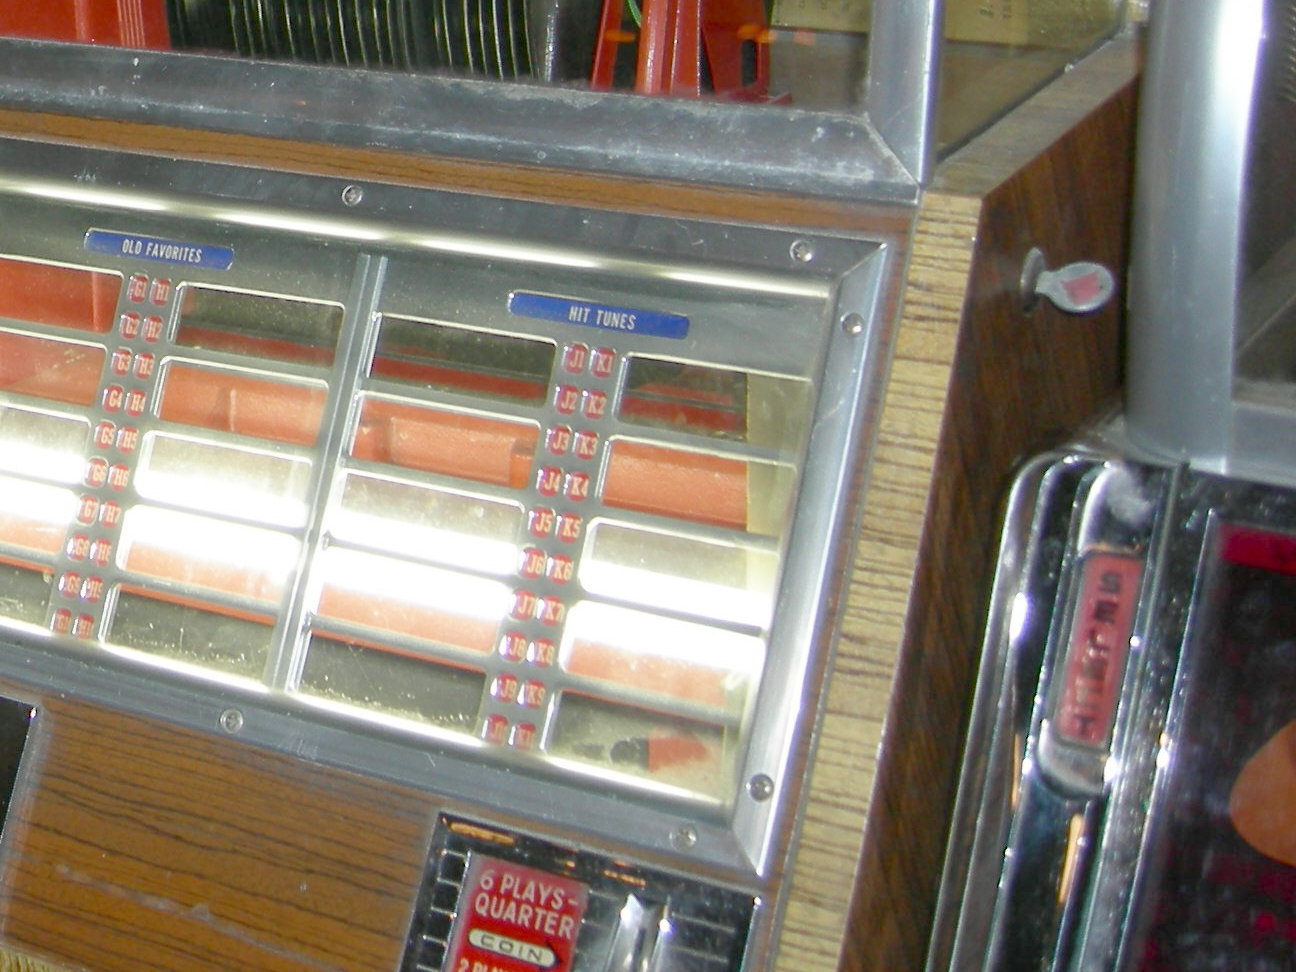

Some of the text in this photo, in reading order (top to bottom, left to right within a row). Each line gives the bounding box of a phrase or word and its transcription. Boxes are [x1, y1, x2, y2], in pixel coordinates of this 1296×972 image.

[121, 239, 203, 264] OLD FAVORITES
[568, 305, 637, 330] HIT TUNES
[569, 350, 613, 373] J1 K1
[108, 389, 123, 408] G4
[561, 391, 607, 415] J2 K2
[552, 431, 598, 456] J3 K3
[544, 471, 589, 497] J4 K4
[535, 512, 581, 538] J5 K5
[527, 554, 574, 580] J6 K6
[518, 595, 564, 620] J7 K7
[480, 869, 495, 890] 6
[475, 892, 575, 940] QUARTER
[480, 934, 543, 962] COIN
